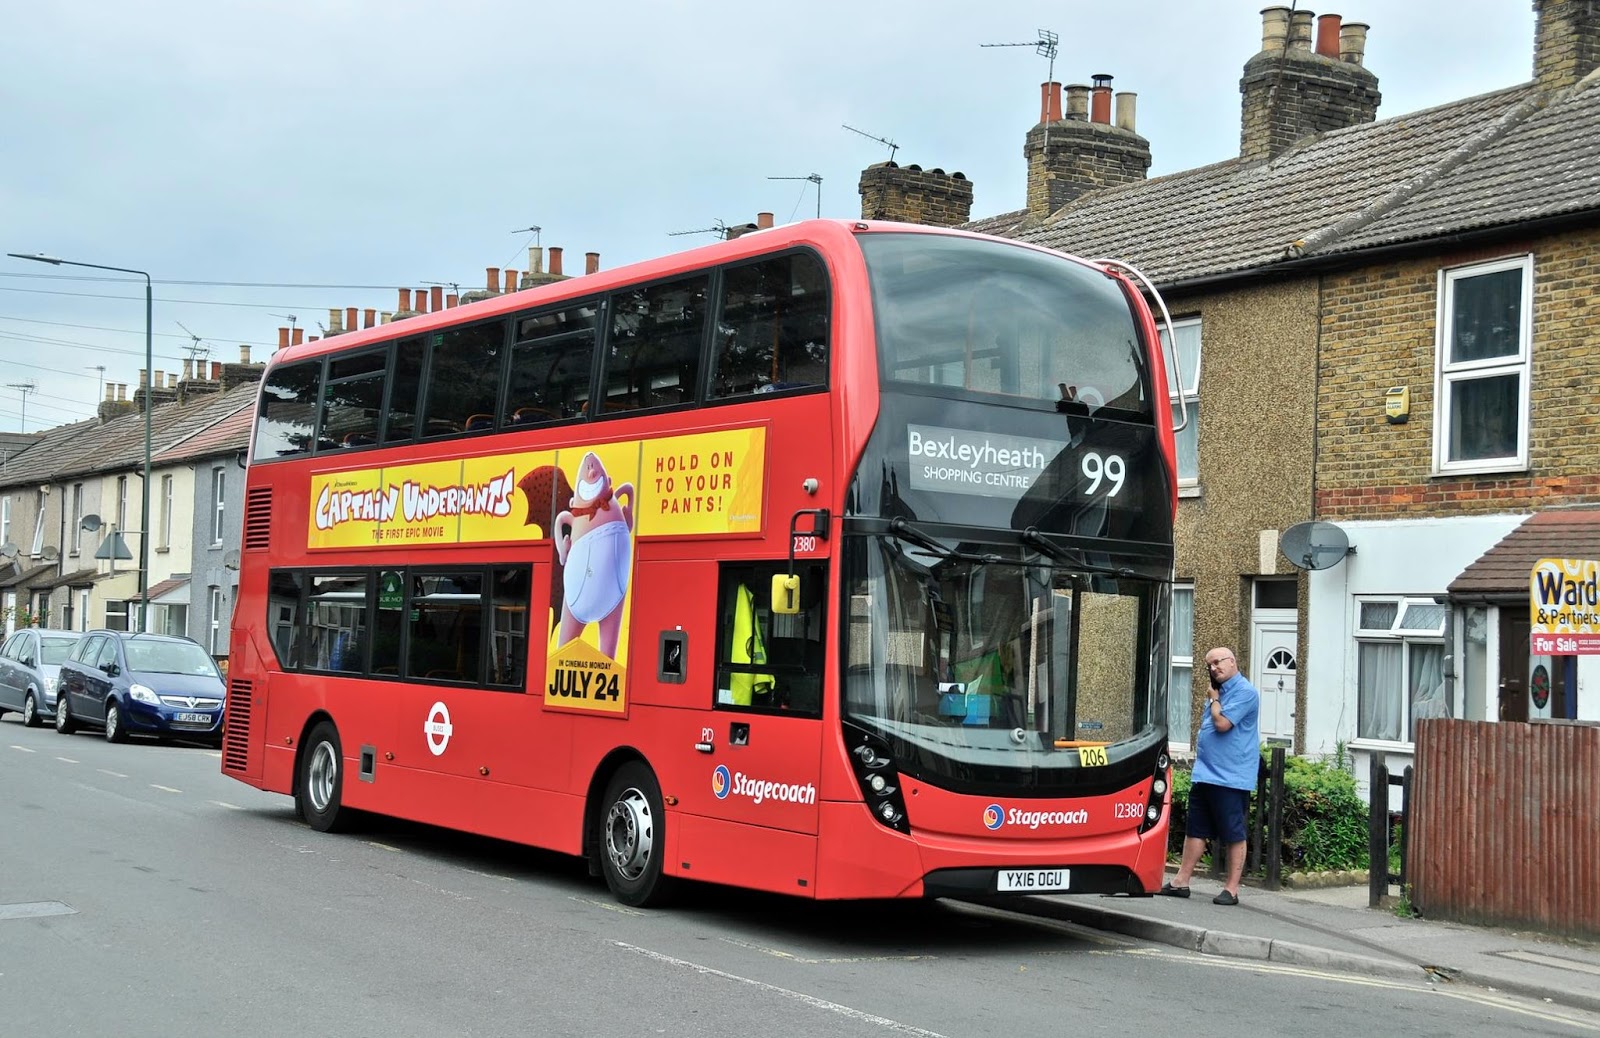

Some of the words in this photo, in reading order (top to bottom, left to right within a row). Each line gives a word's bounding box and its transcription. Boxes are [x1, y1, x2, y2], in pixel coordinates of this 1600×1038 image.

[908, 430, 1046, 470] Bexleyheath
[656, 454, 699, 473] HOLD
[711, 451, 733, 469] ON
[656, 477, 674, 493] TO
[685, 473, 732, 492] YOUR
[923, 466, 982, 485] SHOPPING
[985, 472, 1030, 489] CENTRE
[1081, 452, 1126, 498] 99
[402, 466, 515, 523] UNDERPANTS
[660, 495, 723, 514] PANTS!
[372, 529, 384, 540] THE
[386, 528, 404, 539] FIRST
[405, 527, 421, 538] EPIC
[422, 526, 444, 538] MOVIE
[793, 536, 816, 552] 2380
[1536, 571, 1597, 607] Ward
[1537, 608, 1549, 625] &
[1550, 609, 1599, 625] Partners
[1536, 637, 1554, 652] For
[1556, 637, 1577, 652] Sale
[558, 659, 564, 667] IN
[565, 660, 589, 669] CINEMAS
[589, 661, 612, 670] MONDAY
[549, 668, 593, 699] JULY
[594, 672, 620, 702] 24
[701, 727, 714, 743] PD
[1082, 748, 1105, 767] 206
[732, 771, 816, 805] Stagecoach
[1006, 807, 1089, 830] Stagecoach
[1114, 802, 1145, 819] 12380
[1006, 872, 1035, 888] YX16
[1038, 871, 1063, 887] OGU
